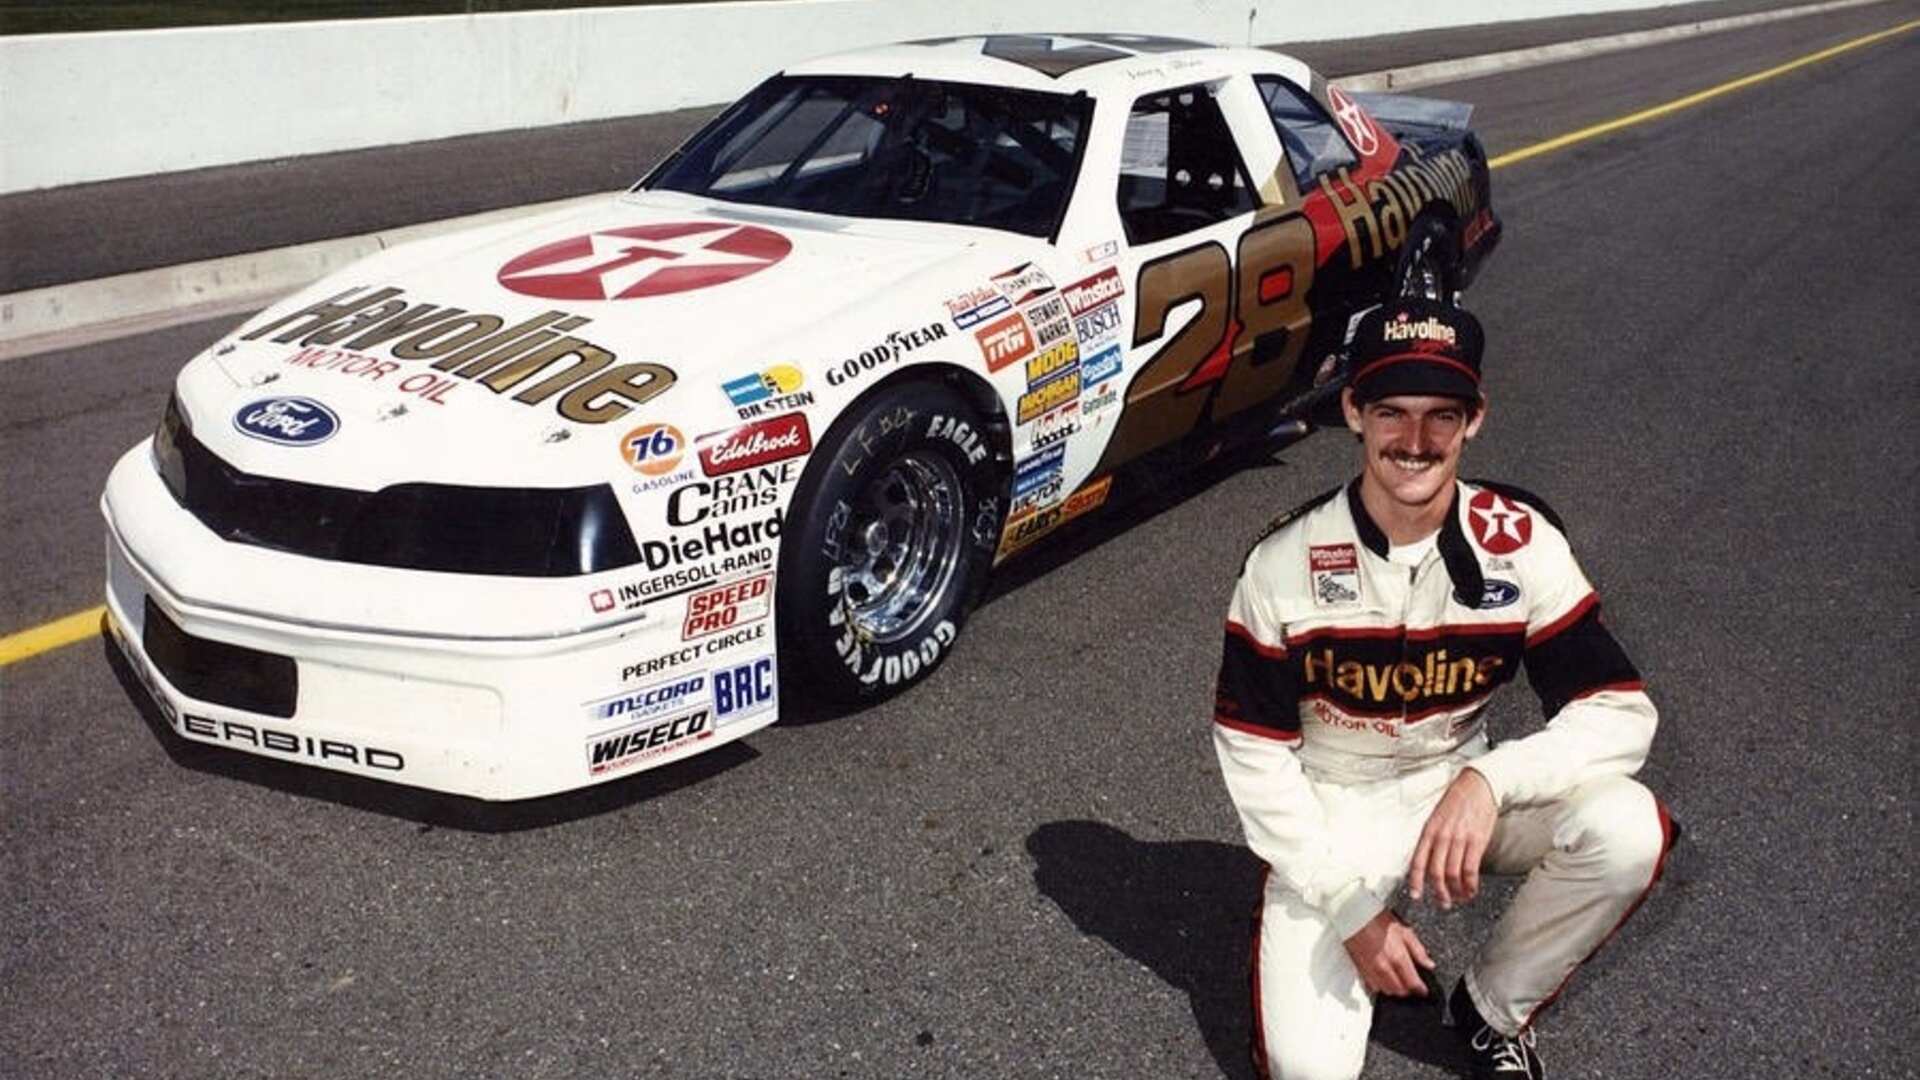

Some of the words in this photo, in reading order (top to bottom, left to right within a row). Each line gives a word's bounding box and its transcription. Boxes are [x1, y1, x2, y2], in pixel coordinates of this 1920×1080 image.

[1028, 299, 1065, 328] STEWART
[1066, 277, 1122, 314] Winston
[1038, 318, 1071, 346] WARNER
[1075, 303, 1121, 343] BUSCH
[1095, 210, 1319, 463] 28
[1384, 316, 1456, 345] Havoline
[240, 286, 678, 424] Havoline
[988, 326, 1028, 363] TRW
[1028, 341, 1079, 379] MOOG
[287, 347, 400, 379] MOTOR
[399, 372, 456, 405] OIL
[737, 391, 815, 420] BILSTEIN
[630, 429, 675, 462] 76
[709, 425, 801, 466] Edelbrock
[926, 415, 987, 465] EAGLE
[632, 470, 696, 495] GASOLINE
[642, 507, 784, 571] DieHard
[618, 547, 773, 602] INGERSOLL-RAND
[691, 577, 768, 618] SPEED
[687, 606, 739, 636] PRO
[622, 645, 703, 682] PERFECT
[706, 624, 767, 656] CIRCLE
[714, 658, 772, 715] BRC
[592, 710, 709, 764] WISECO
